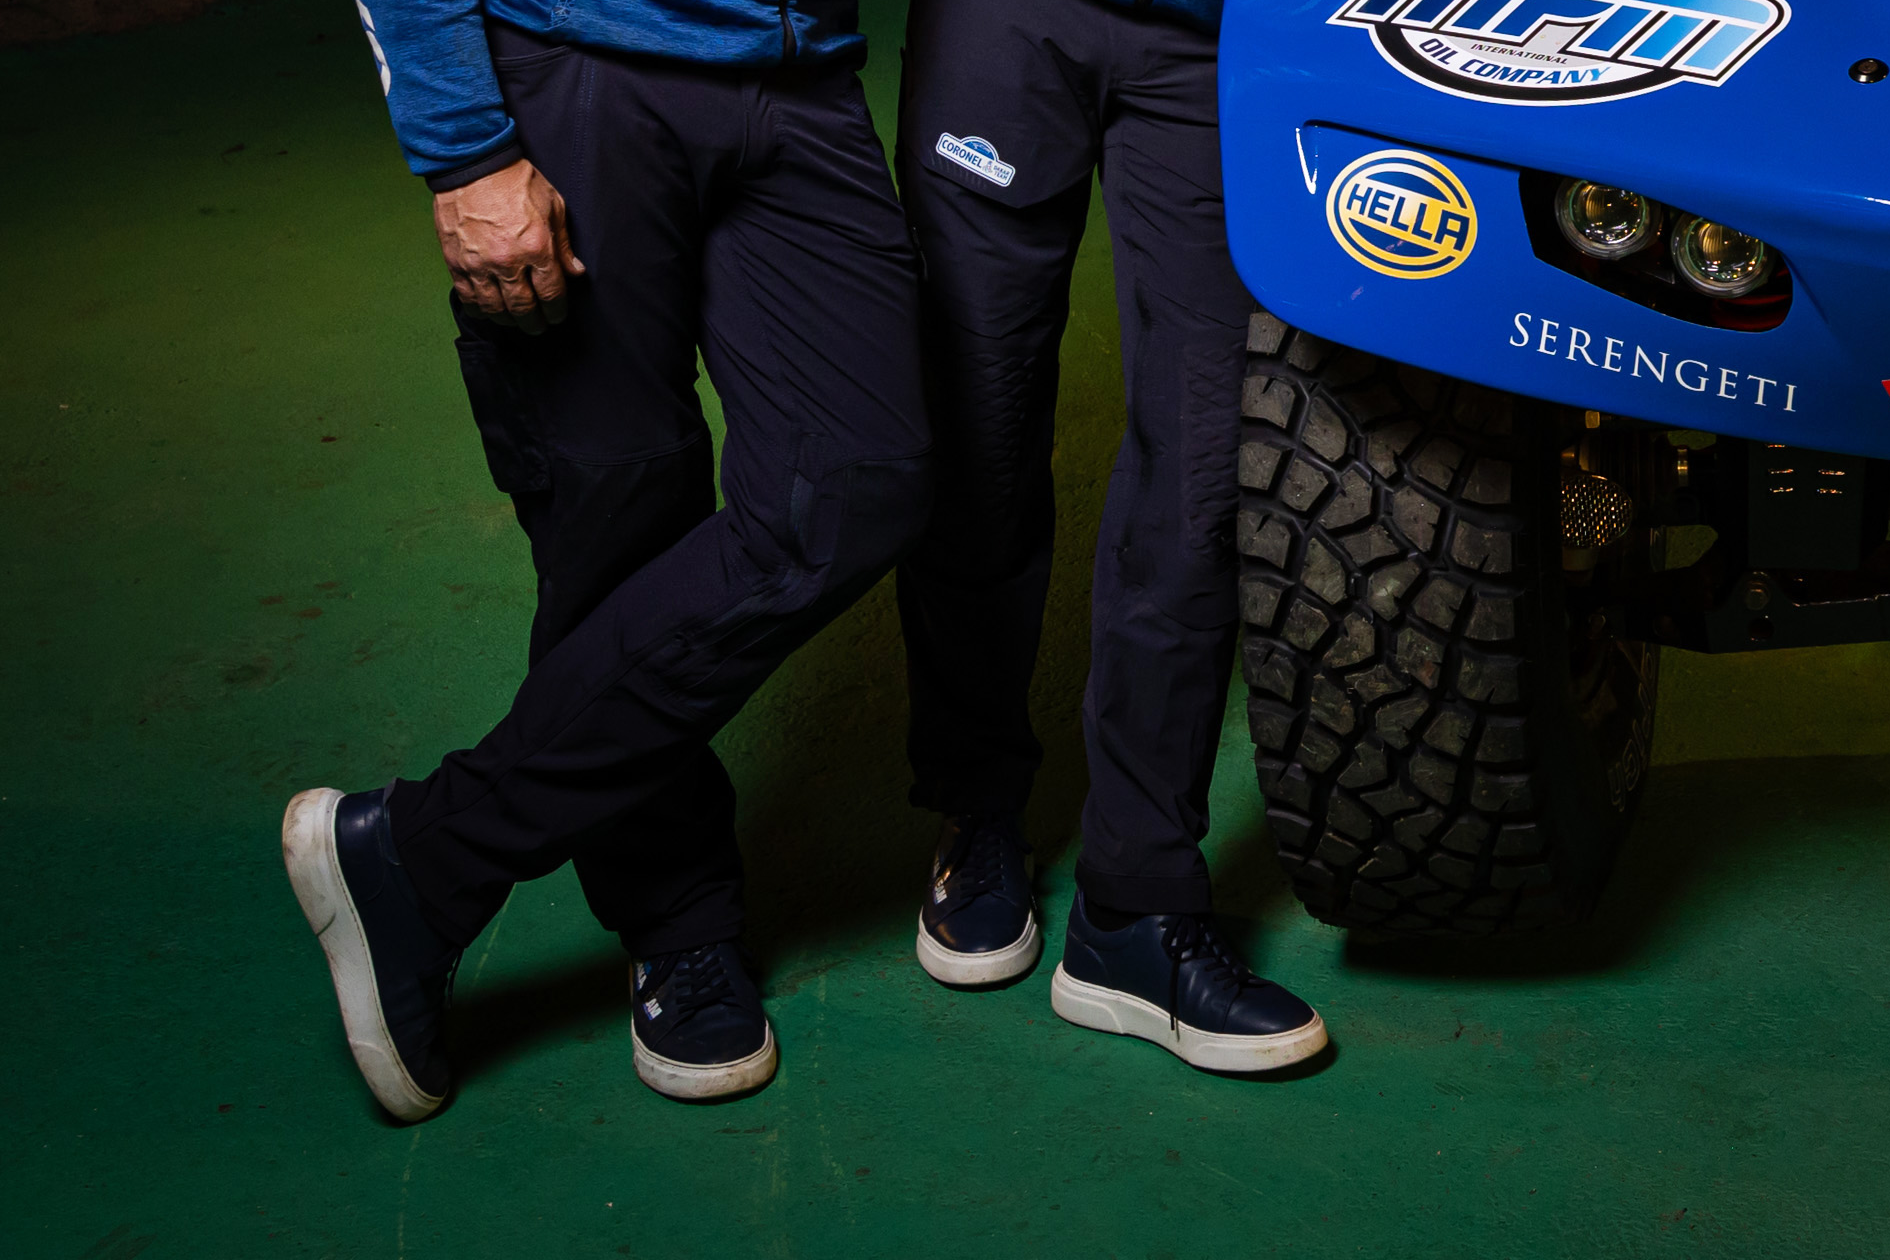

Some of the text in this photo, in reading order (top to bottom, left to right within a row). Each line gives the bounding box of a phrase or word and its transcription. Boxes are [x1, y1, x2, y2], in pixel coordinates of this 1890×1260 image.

[1419, 37, 1612, 85] OIL COMPANY
[1470, 43, 1568, 66] INTERNATIONAL
[941, 139, 982, 169] CORONEL
[1345, 181, 1473, 253] HELLA
[1509, 312, 1798, 413] SERENGETI
